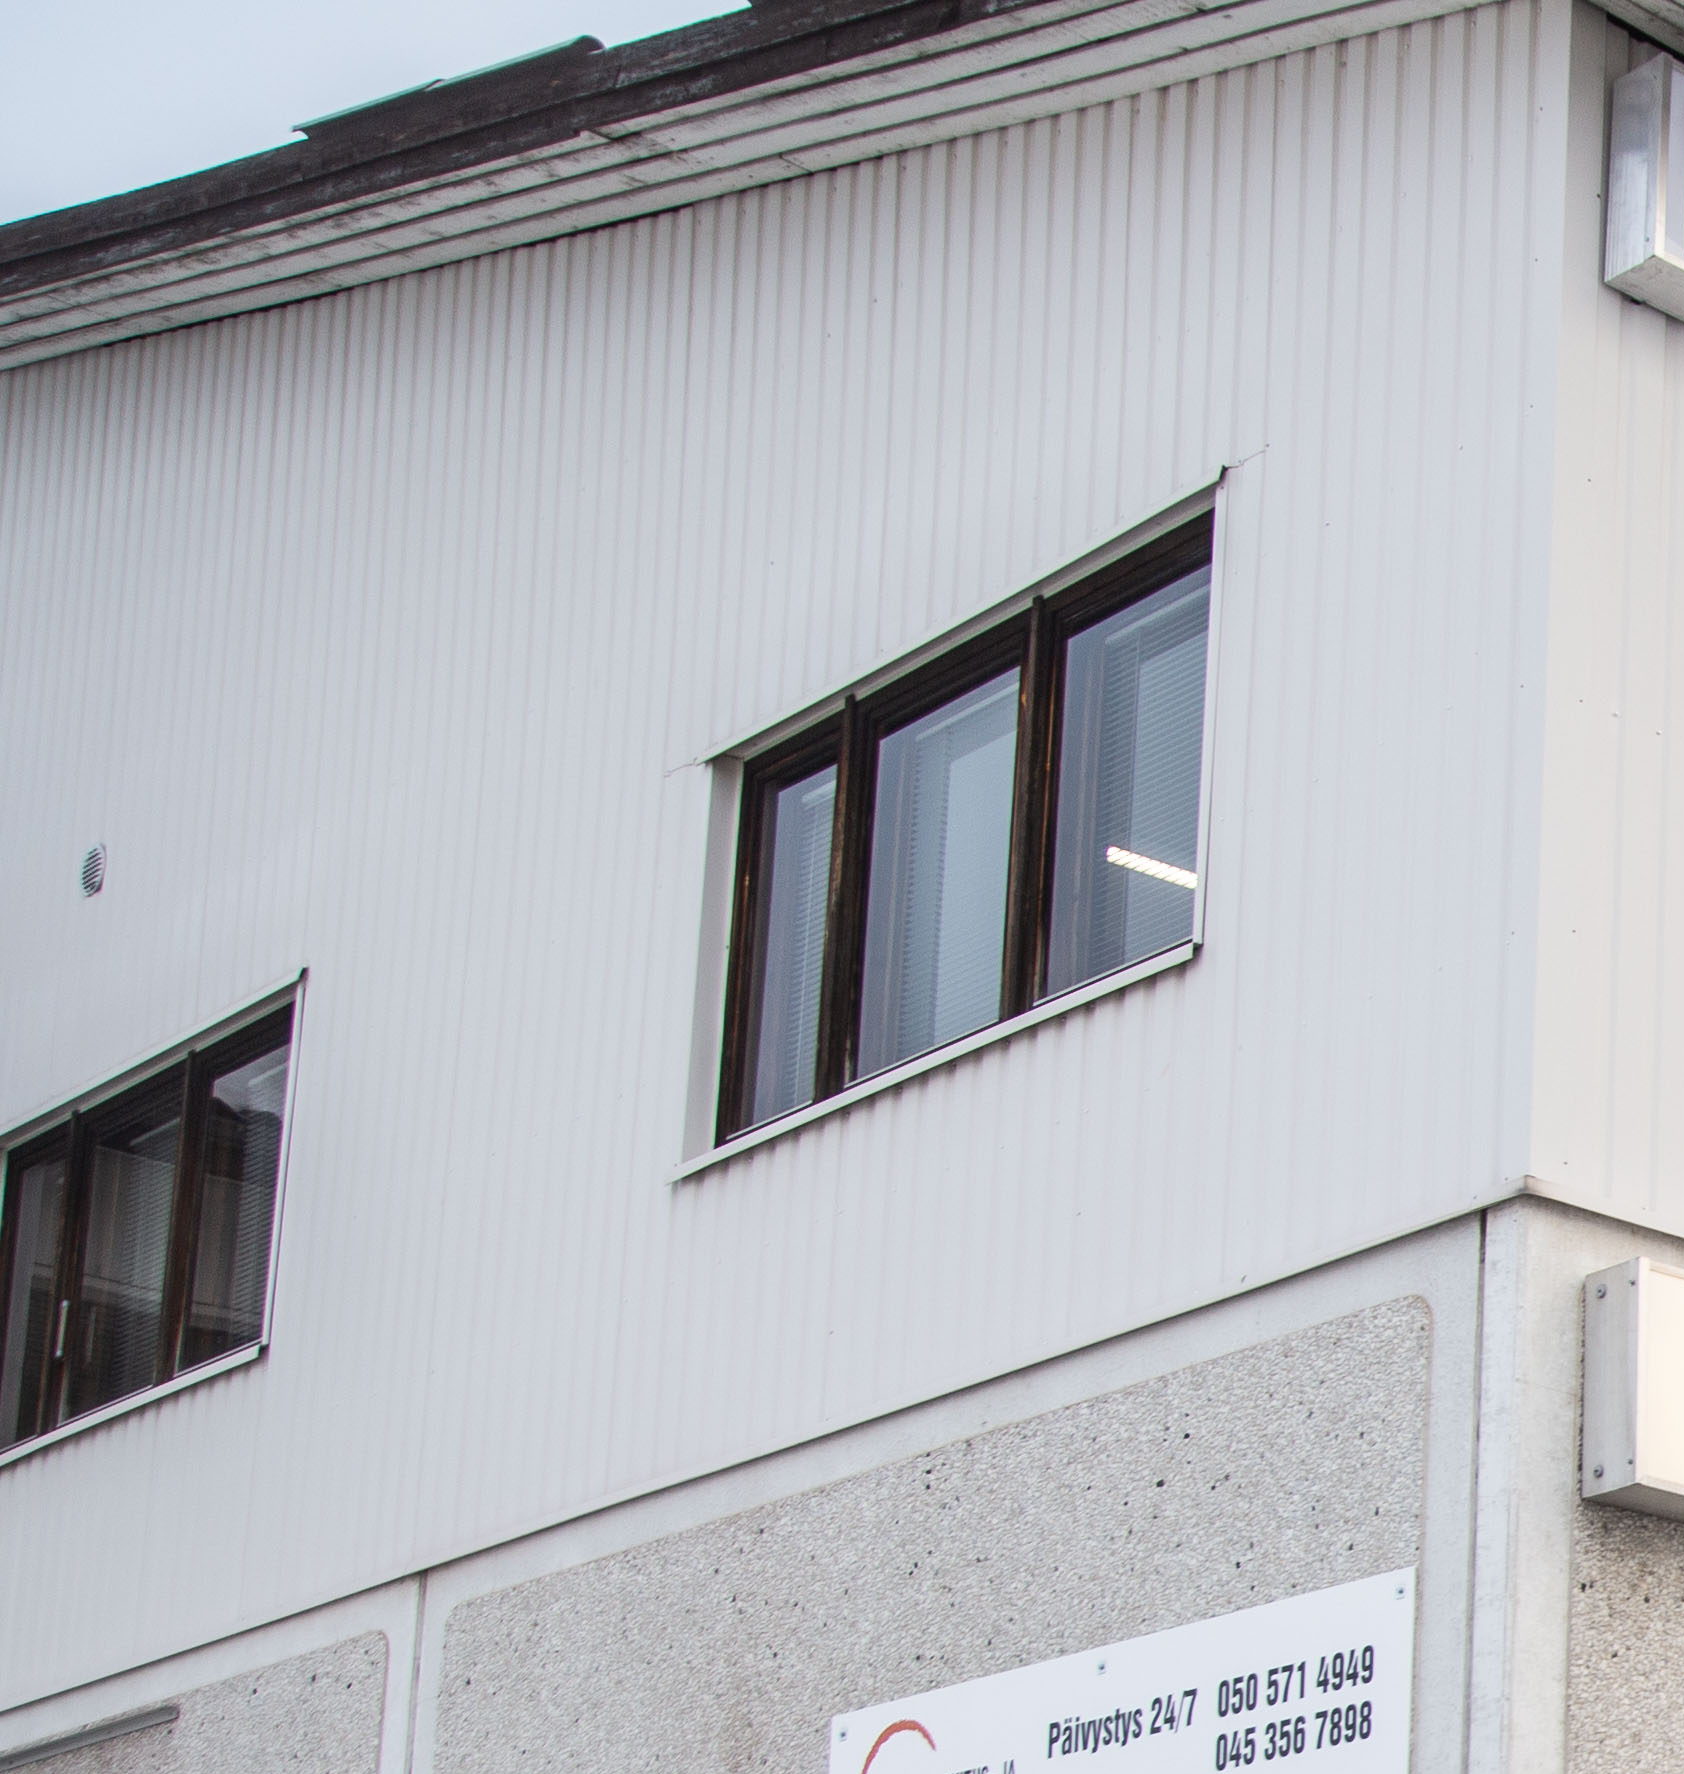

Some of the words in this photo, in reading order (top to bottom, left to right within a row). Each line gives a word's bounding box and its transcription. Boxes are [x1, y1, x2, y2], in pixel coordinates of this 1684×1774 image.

[1047, 1705, 1143, 1758] Päivystys
[1150, 1689, 1198, 1733] 24/7
[1217, 1672, 1258, 1718] 050
[1266, 1661, 1307, 1707] 571
[1316, 1644, 1375, 1693] 4949
[1215, 1727, 1256, 1771] 045
[1264, 1716, 1305, 1763] 356
[1315, 1700, 1372, 1750] 7898
